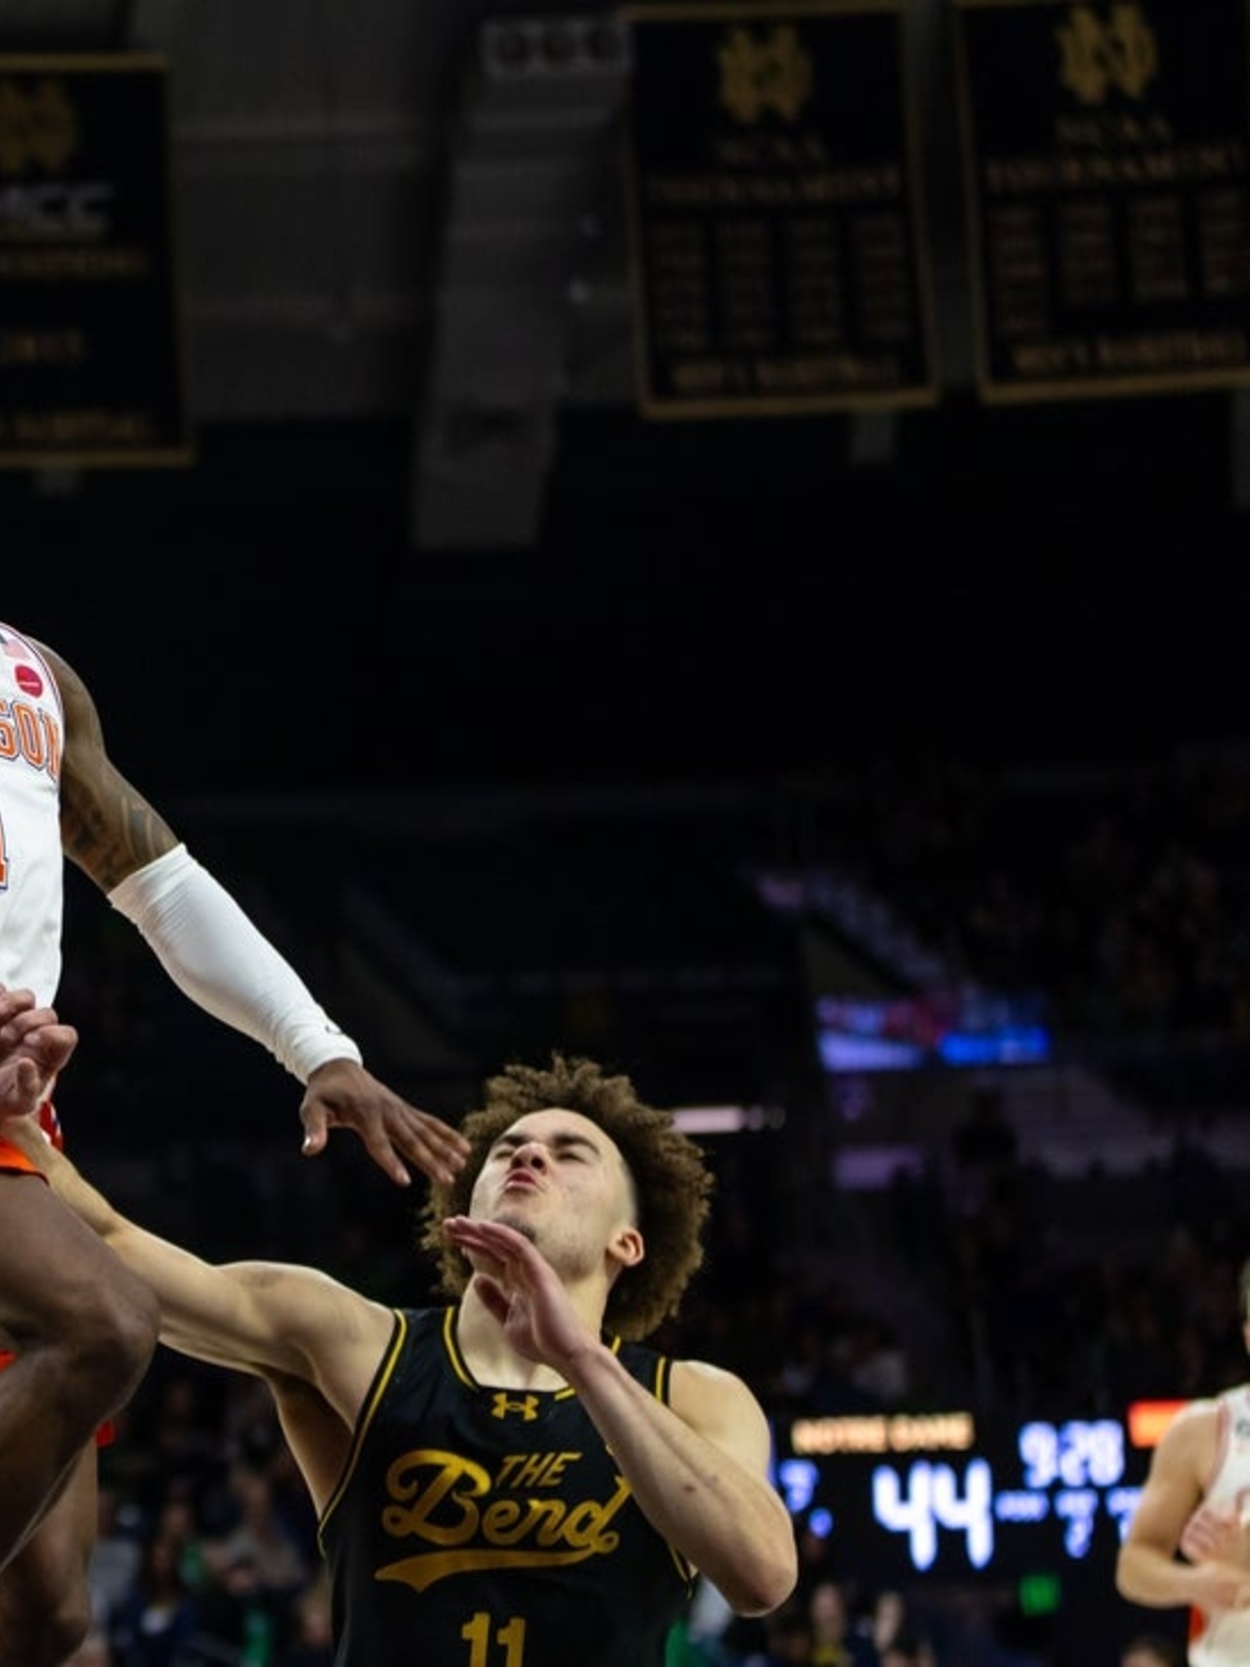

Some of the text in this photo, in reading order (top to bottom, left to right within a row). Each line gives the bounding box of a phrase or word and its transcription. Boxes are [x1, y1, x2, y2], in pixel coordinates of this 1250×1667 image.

[379, 1446, 632, 1556] Bend
[493, 1450, 584, 1490] THE
[872, 1460, 994, 1570] 44
[461, 1609, 528, 1667] 11
